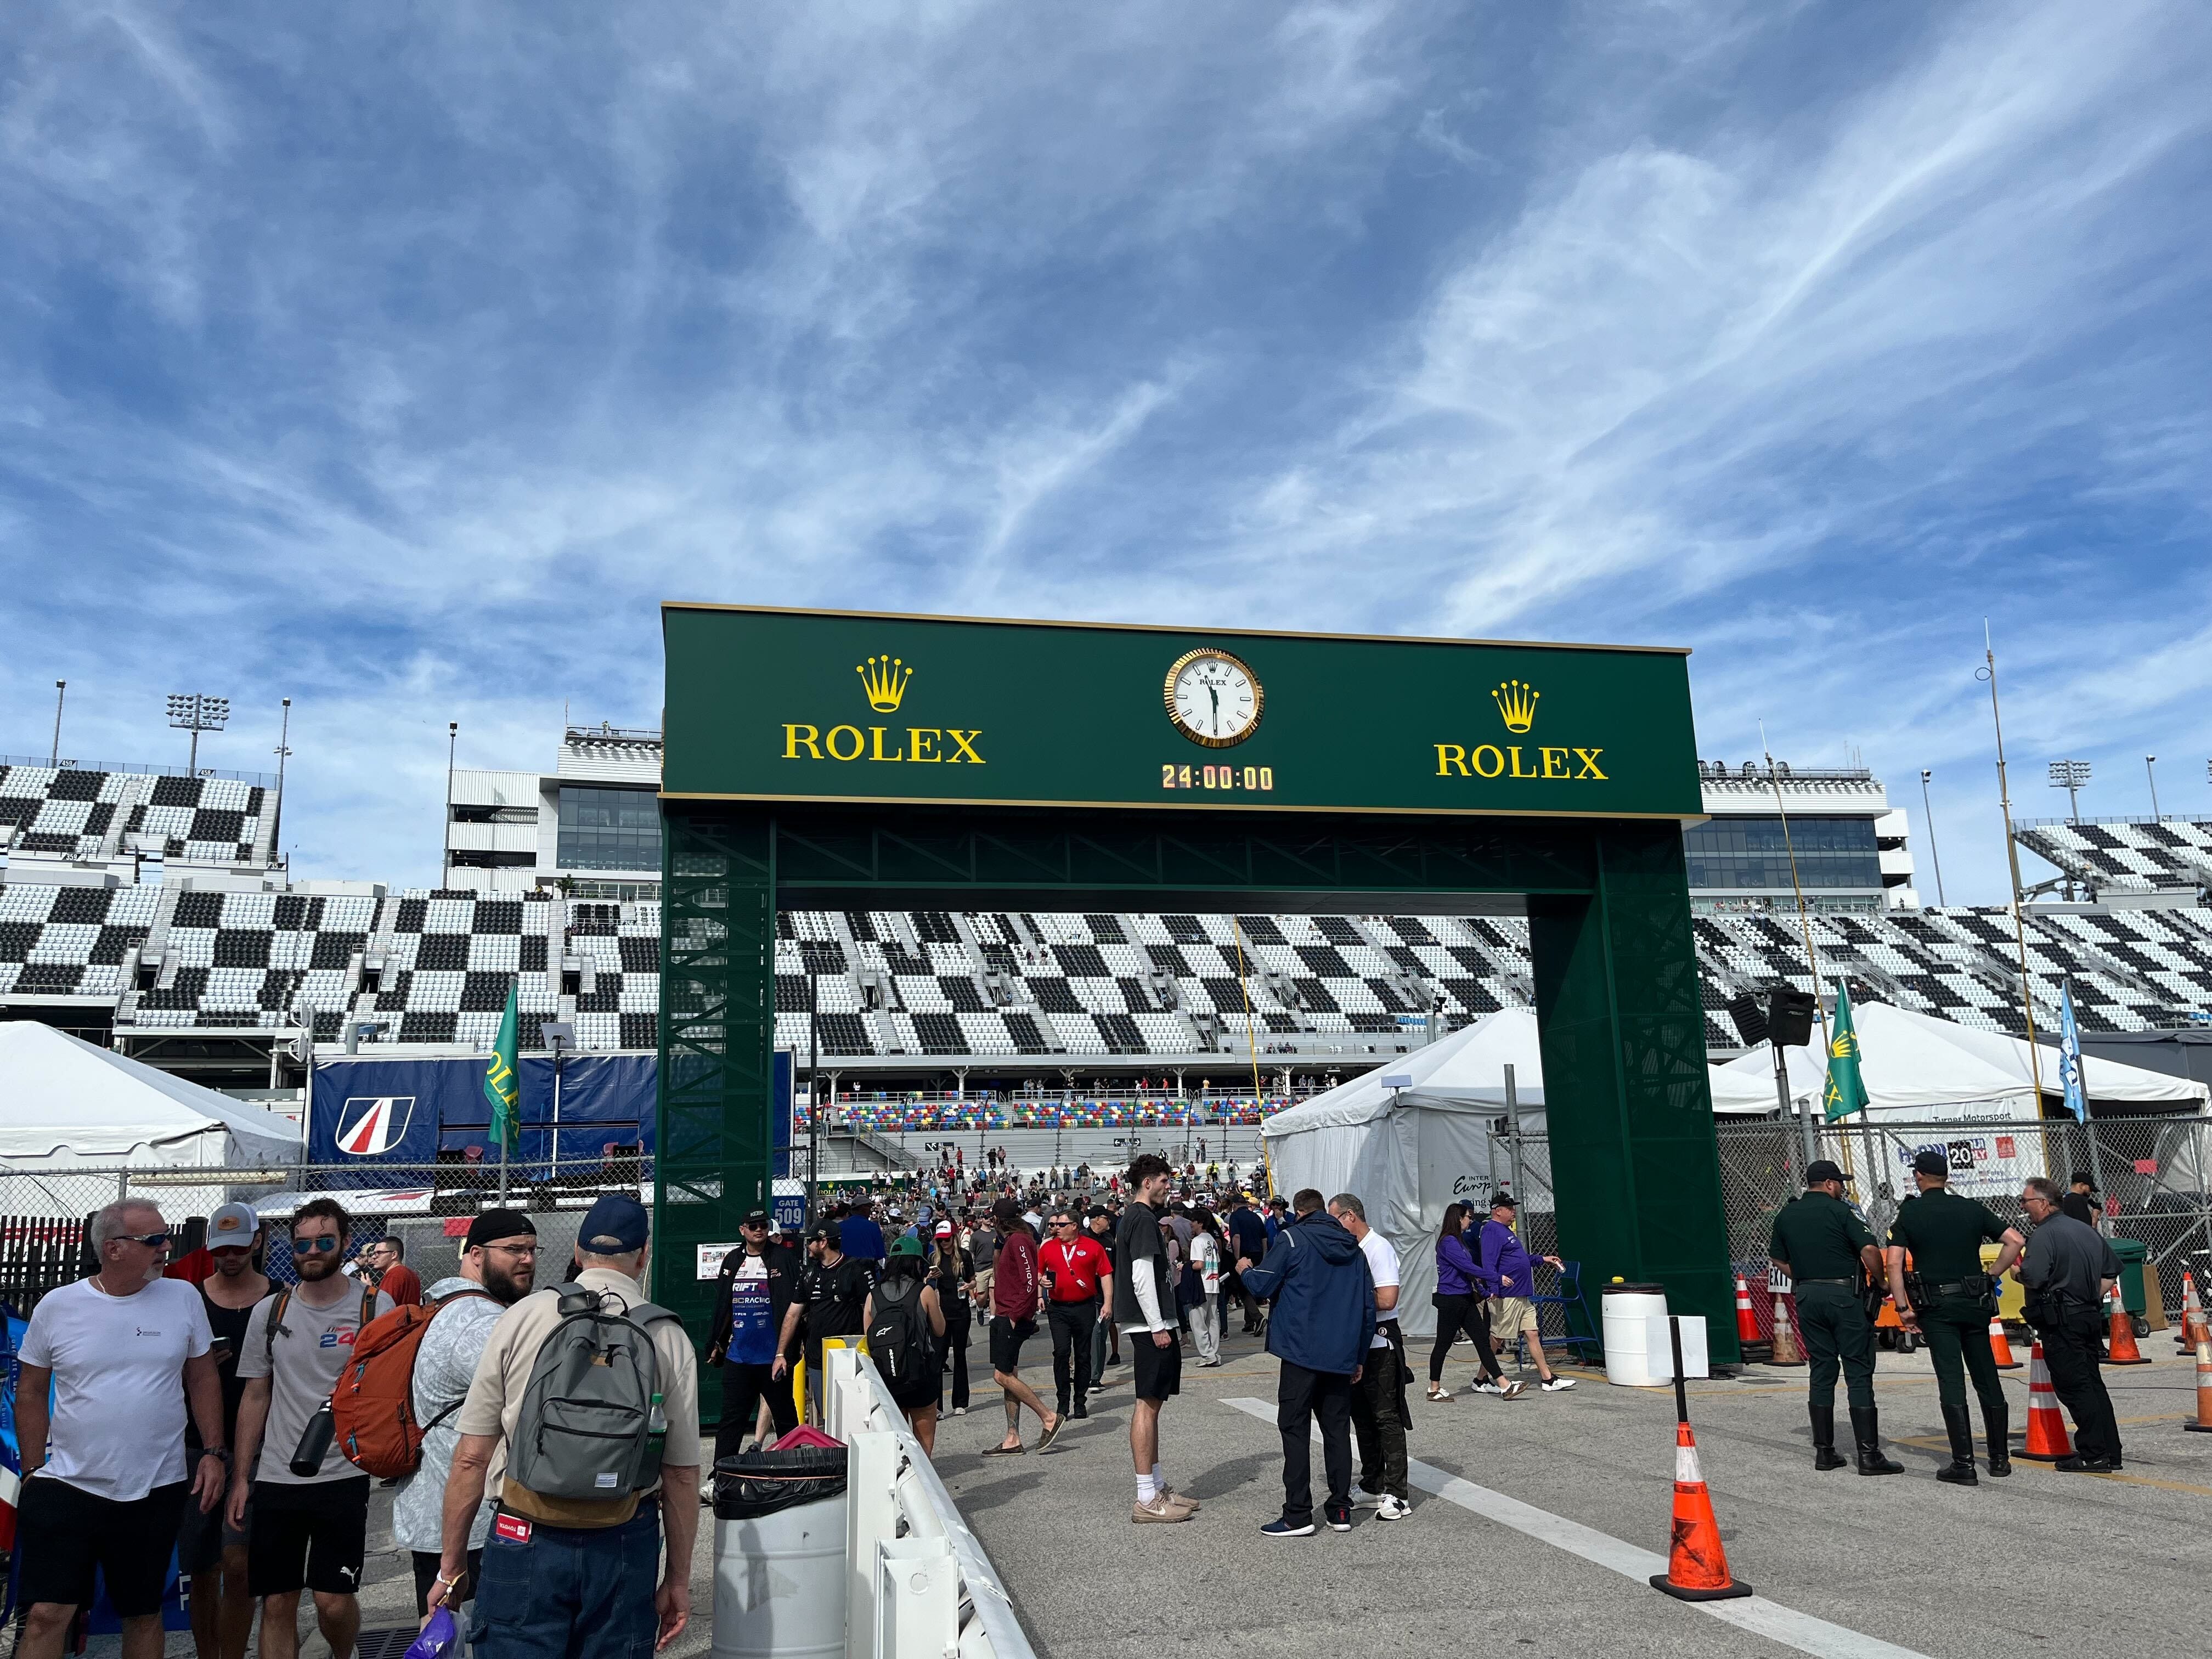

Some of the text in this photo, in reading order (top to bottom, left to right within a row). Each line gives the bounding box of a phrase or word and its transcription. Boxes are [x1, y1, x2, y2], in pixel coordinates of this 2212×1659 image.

[781, 723, 986, 764] ROLEX
[1434, 744, 1609, 780] ROLEX
[1162, 764, 1273, 790] 24:00:00
[1963, 1112, 2012, 1122] Motorsport
[1950, 1148, 1971, 1163] 20
[775, 1208, 802, 1224] 509
[1019, 1245, 1032, 1293] CADILLAC
[320, 1332, 354, 1348] 24
[499, 1522, 517, 1532] TOYOTA
